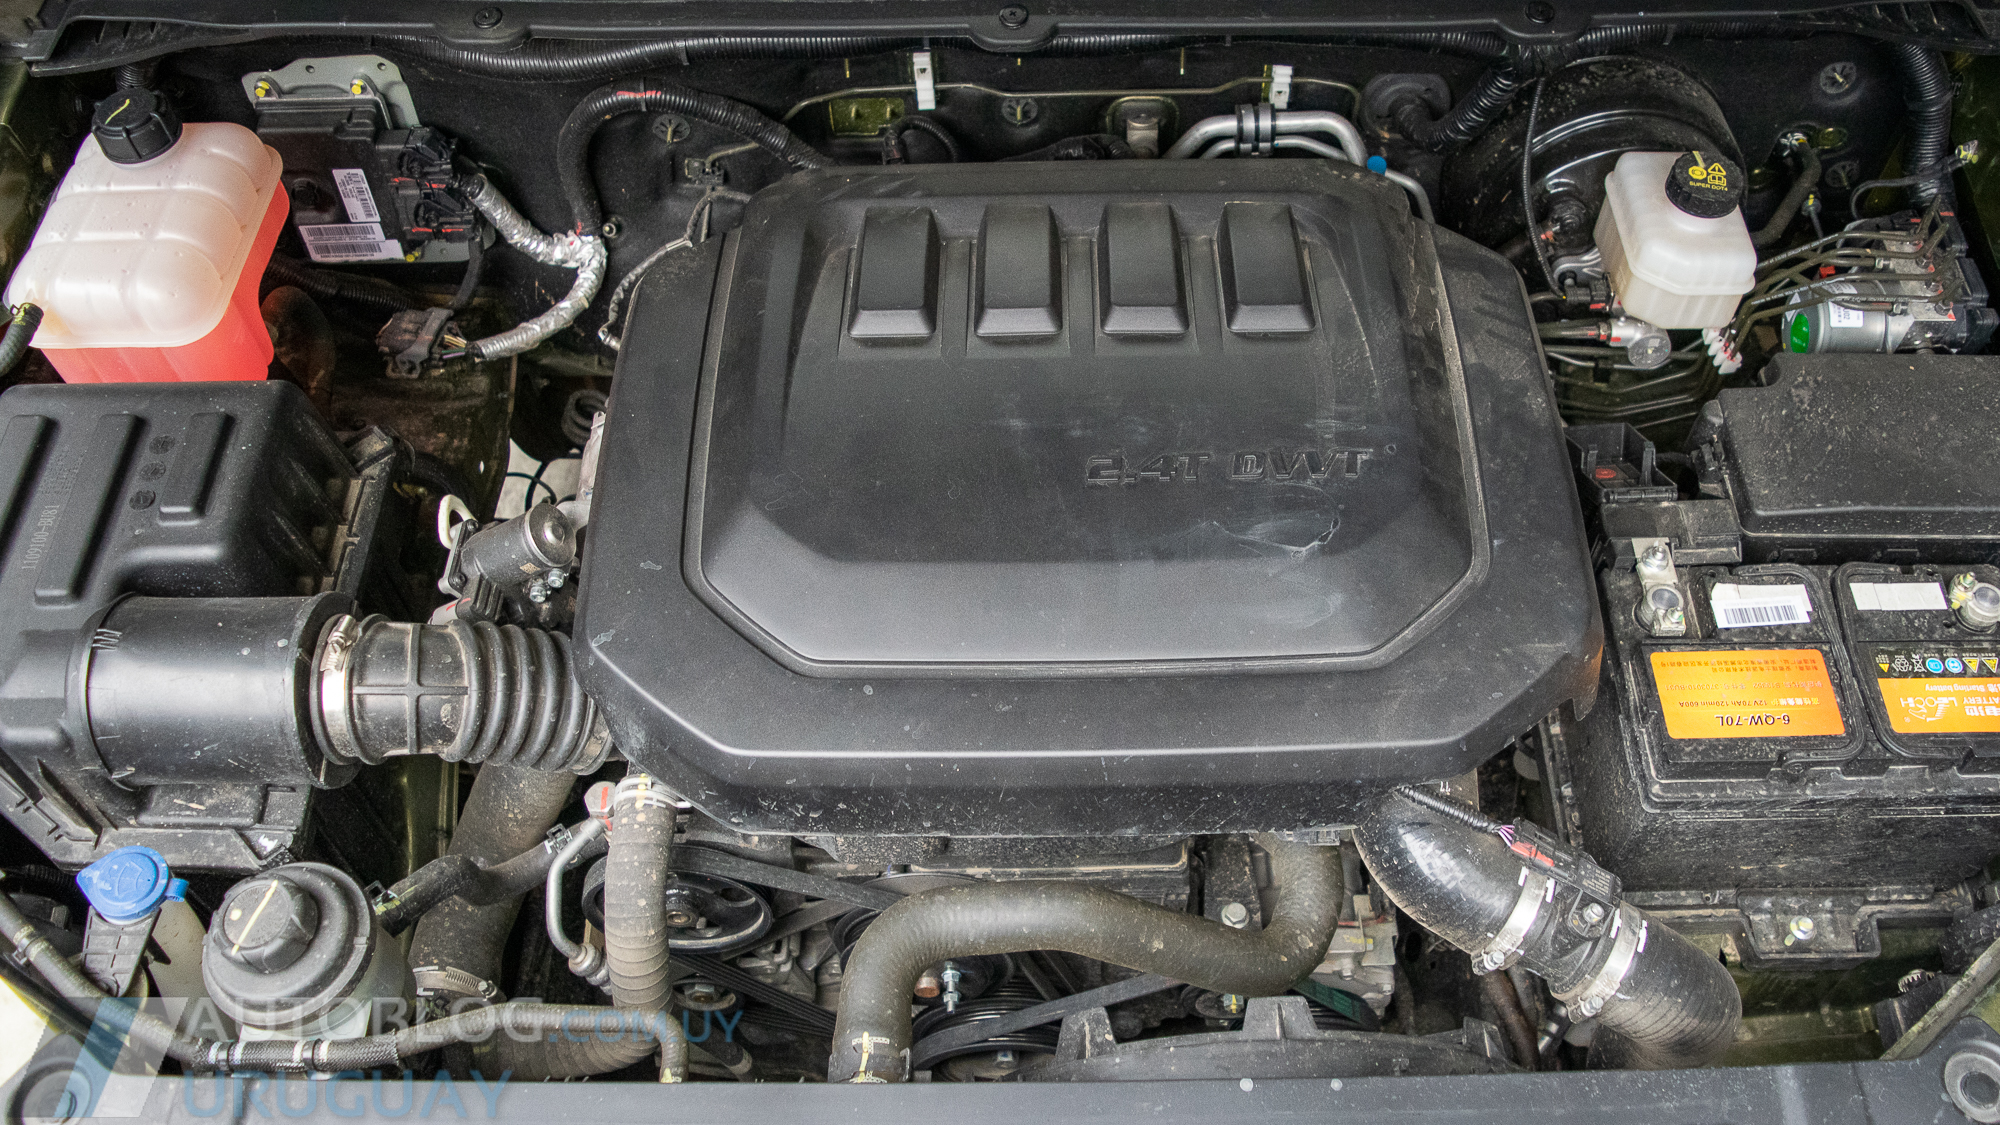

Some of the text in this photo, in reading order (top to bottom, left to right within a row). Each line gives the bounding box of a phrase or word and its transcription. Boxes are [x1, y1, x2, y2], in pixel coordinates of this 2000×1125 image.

[1085, 449, 1374, 485] 2.4T DVVT
[22, 504, 60, 570] 1109100-BU81
[1925, 683, 1953, 692] battery
[1954, 683, 1986, 692] Starting
[1715, 713, 1791, 726] 6-QW-70L
